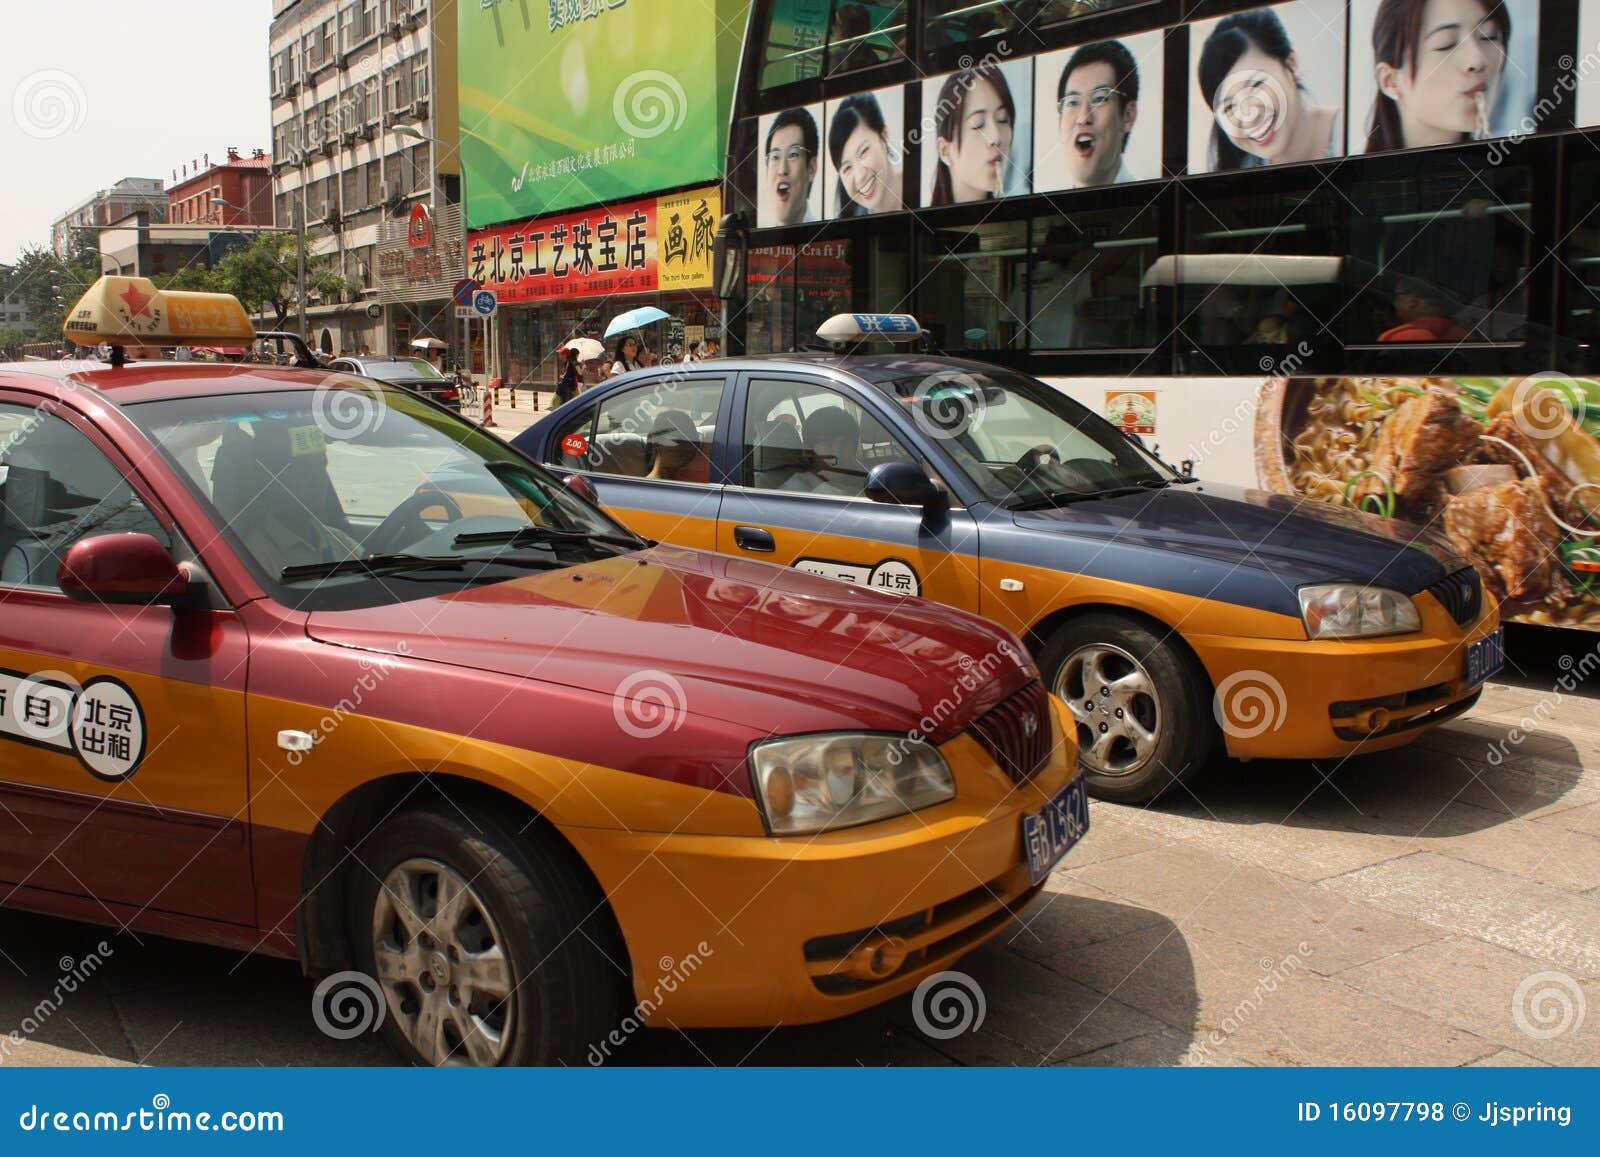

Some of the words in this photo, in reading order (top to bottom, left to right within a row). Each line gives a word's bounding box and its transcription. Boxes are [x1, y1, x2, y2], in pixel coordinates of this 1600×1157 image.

[471, 209, 648, 286] 老北京工艺珠宝店
[663, 198, 715, 272] 画廊
[565, 438, 582, 449] 2.00
[878, 571, 911, 590] 北京
[84, 698, 133, 732] 北京
[82, 727, 131, 762] 出租
